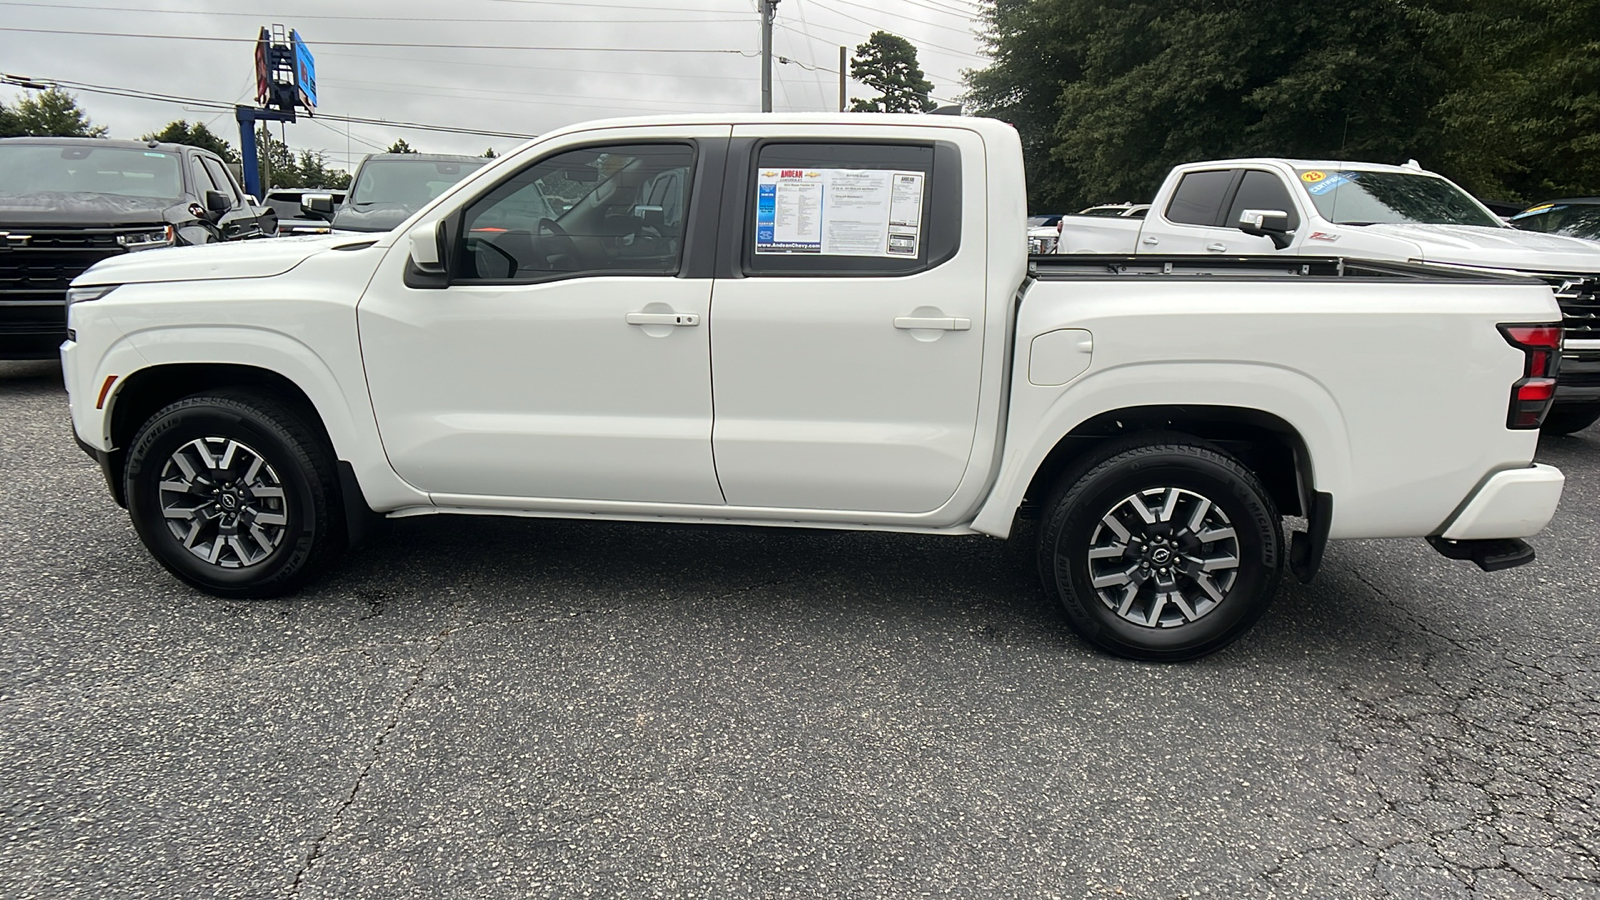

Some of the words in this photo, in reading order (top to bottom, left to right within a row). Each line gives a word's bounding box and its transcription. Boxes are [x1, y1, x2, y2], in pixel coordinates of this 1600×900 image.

[781, 170, 803, 178] ANDEAN
[1306, 171, 1322, 181] 23
[1249, 501, 1273, 564] MICHELIN
